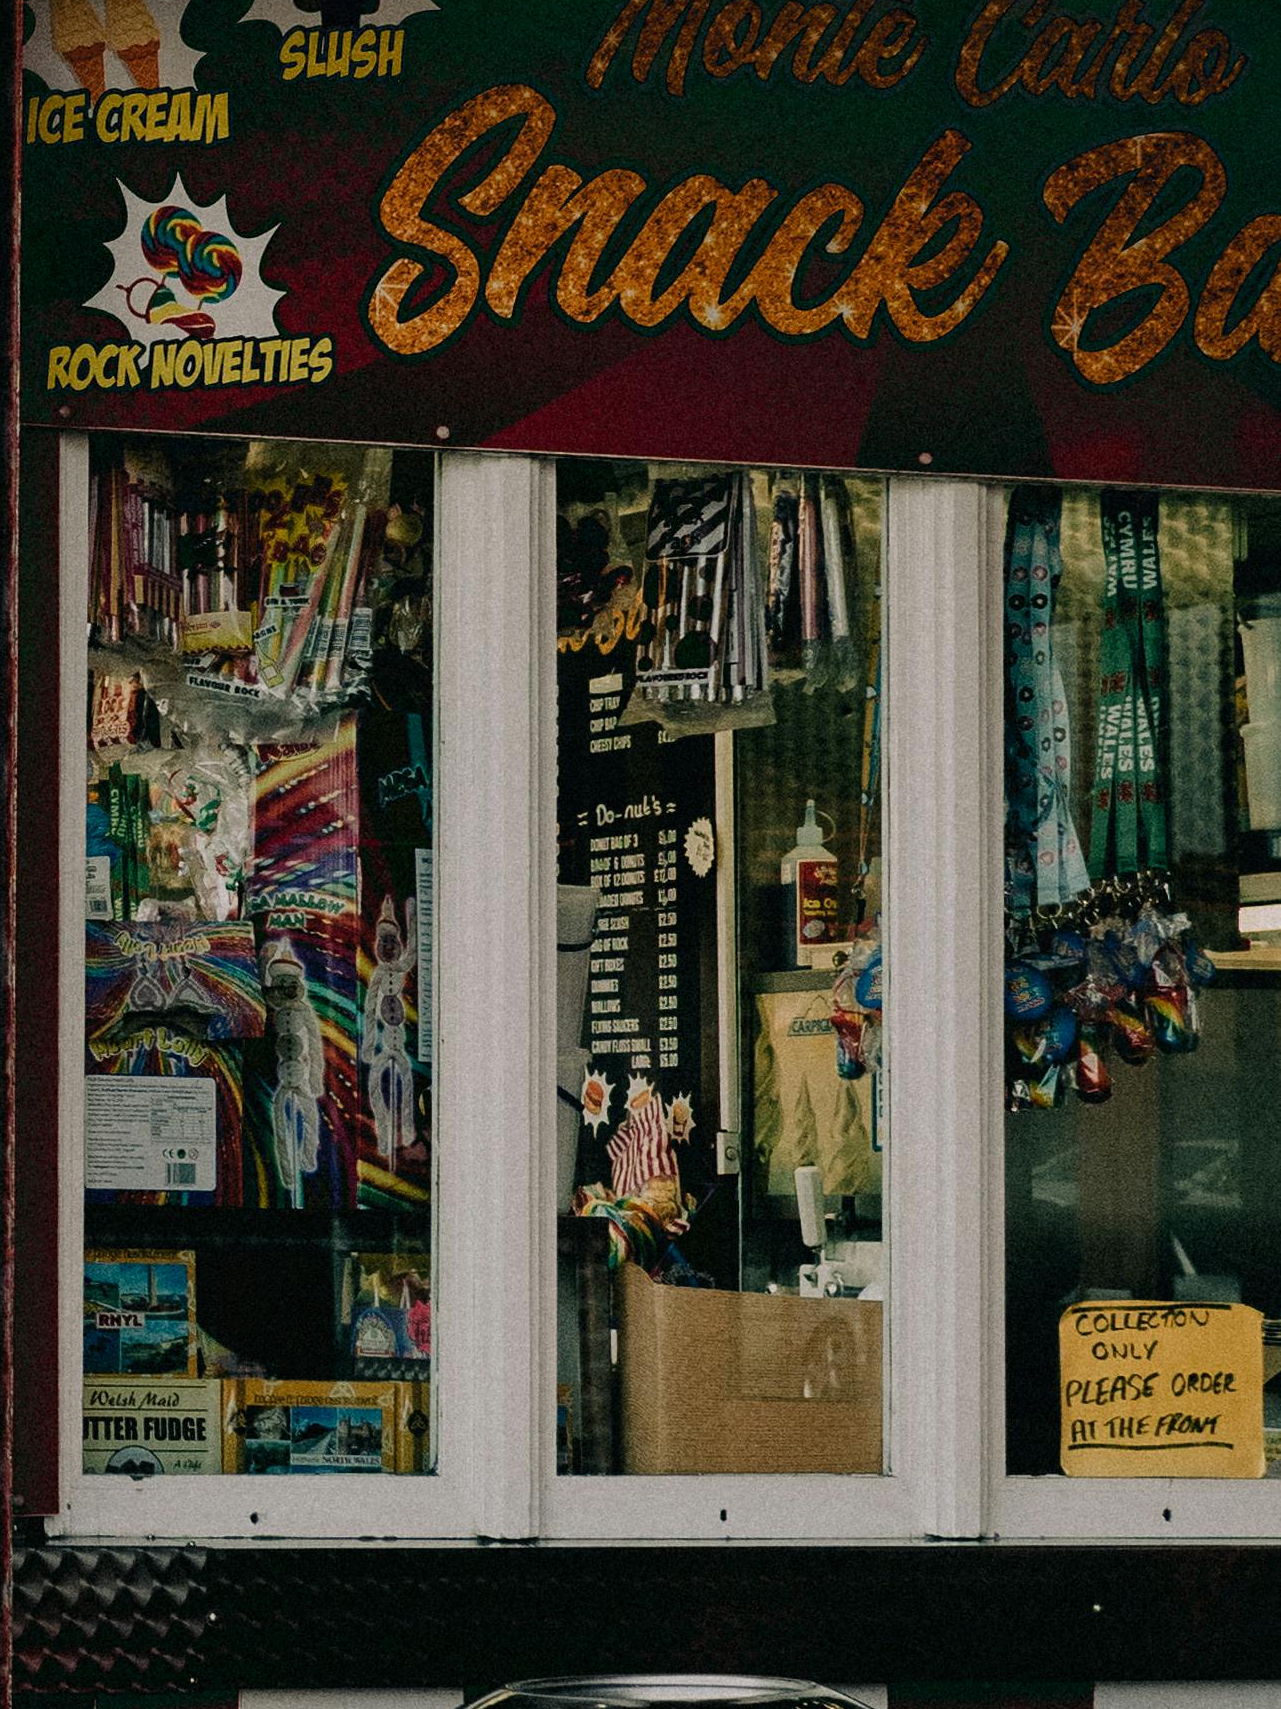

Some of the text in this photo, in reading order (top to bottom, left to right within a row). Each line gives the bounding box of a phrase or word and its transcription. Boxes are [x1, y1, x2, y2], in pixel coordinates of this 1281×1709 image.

[279, 28, 405, 81] SLUSH
[26, 90, 230, 145] ICE CREAM
[367, 82, 1010, 355] Snack
[47, 336, 334, 391] ROCK NOVELTIES
[1117, 510, 1138, 591] CYMRU
[234, 684, 261, 698] ROCK
[273, 891, 345, 914] MALLOW
[268, 914, 306, 931] MAN
[156, 1026, 209, 1067] Lolly
[1091, 1340, 1158, 1360] ONLY
[90, 1390, 180, 1410] Welsh Maid
[1066, 1371, 1237, 1408] PLEASE ORDER
[83, 1416, 207, 1442] TTER FUDGE
[1071, 1412, 1222, 1442] AT THE FRONT
